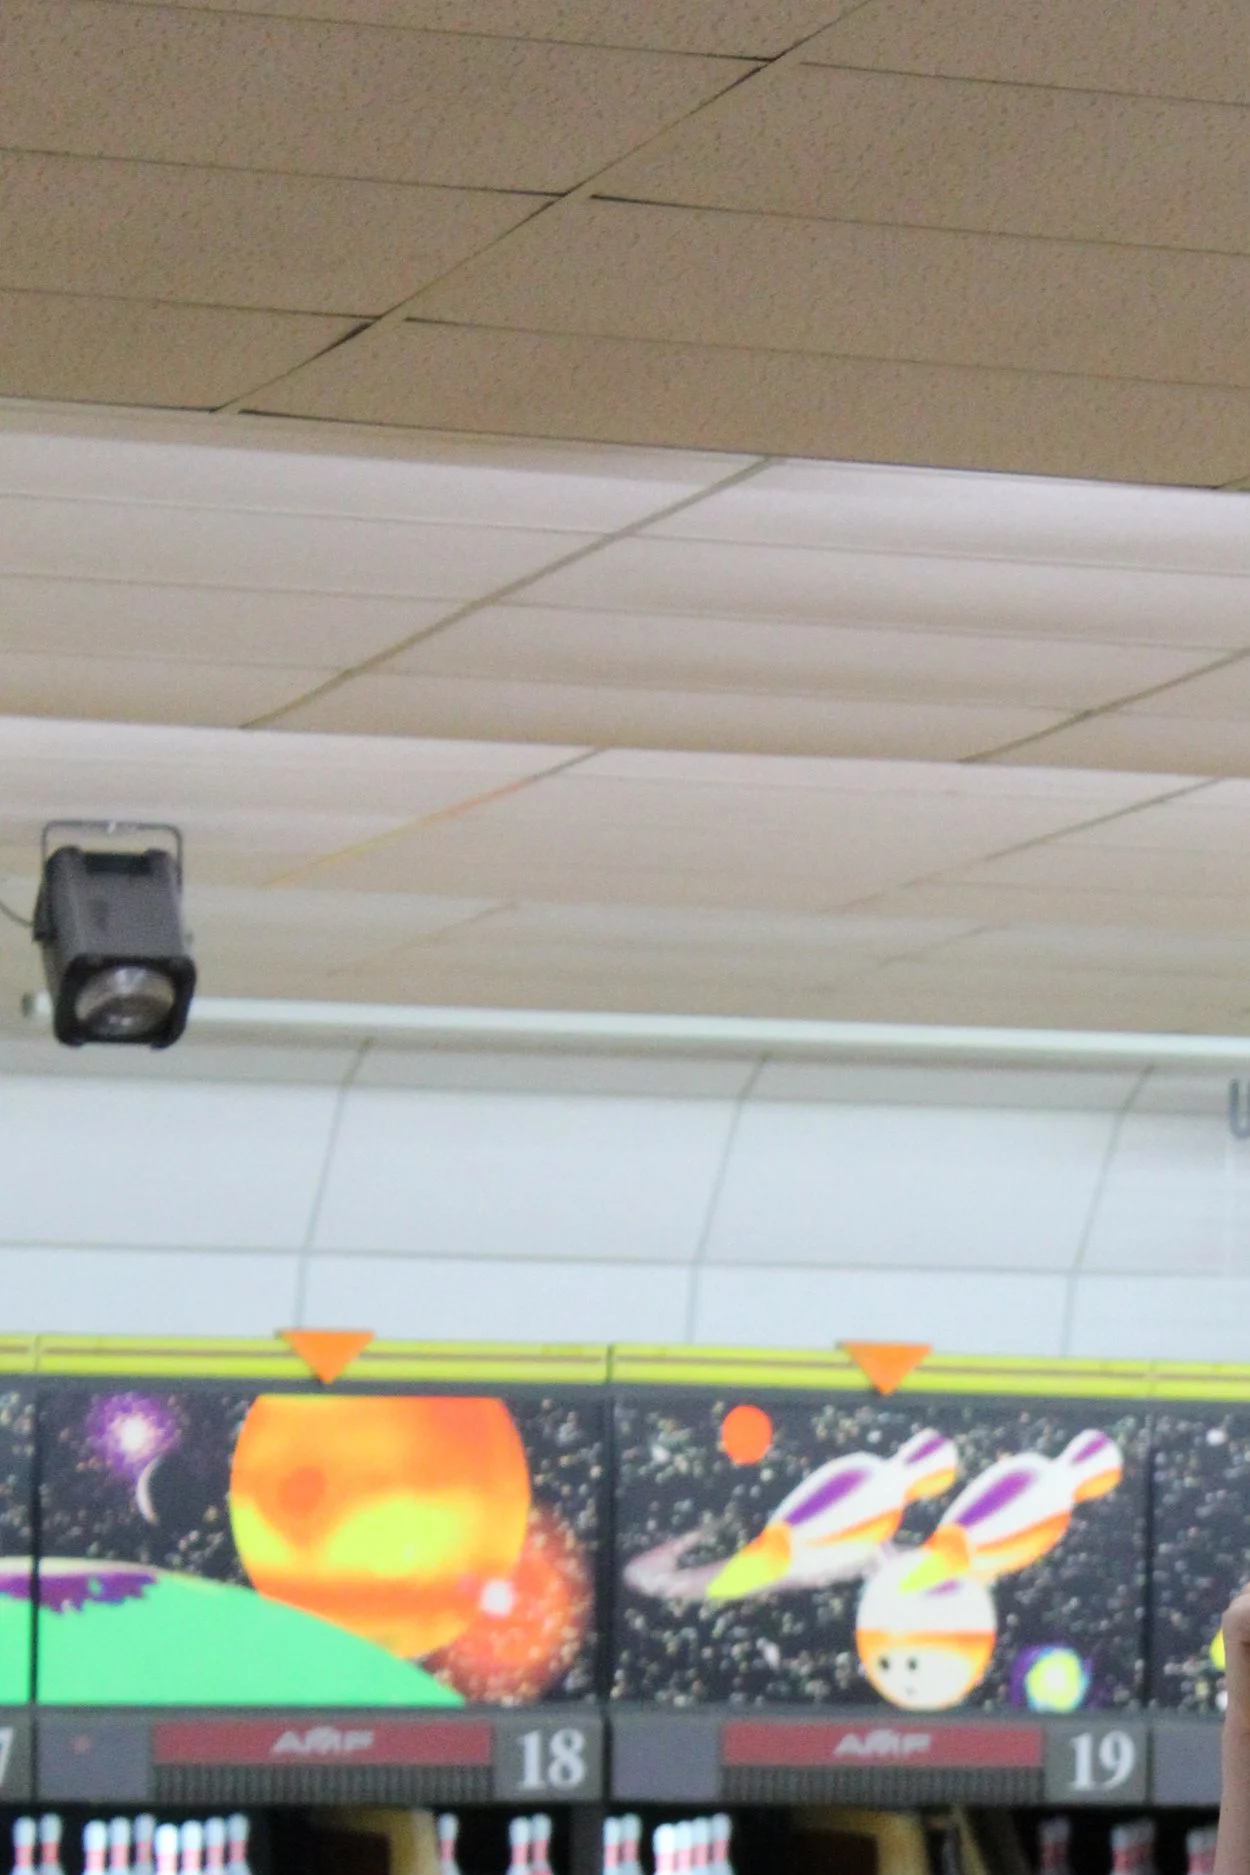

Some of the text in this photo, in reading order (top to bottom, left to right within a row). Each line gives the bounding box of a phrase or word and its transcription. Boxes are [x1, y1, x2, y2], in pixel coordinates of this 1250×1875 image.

[272, 1727, 375, 1755] AMF
[516, 1728, 587, 1790] 18
[834, 1729, 933, 1757] AMF
[1068, 1730, 1136, 1791] 19
